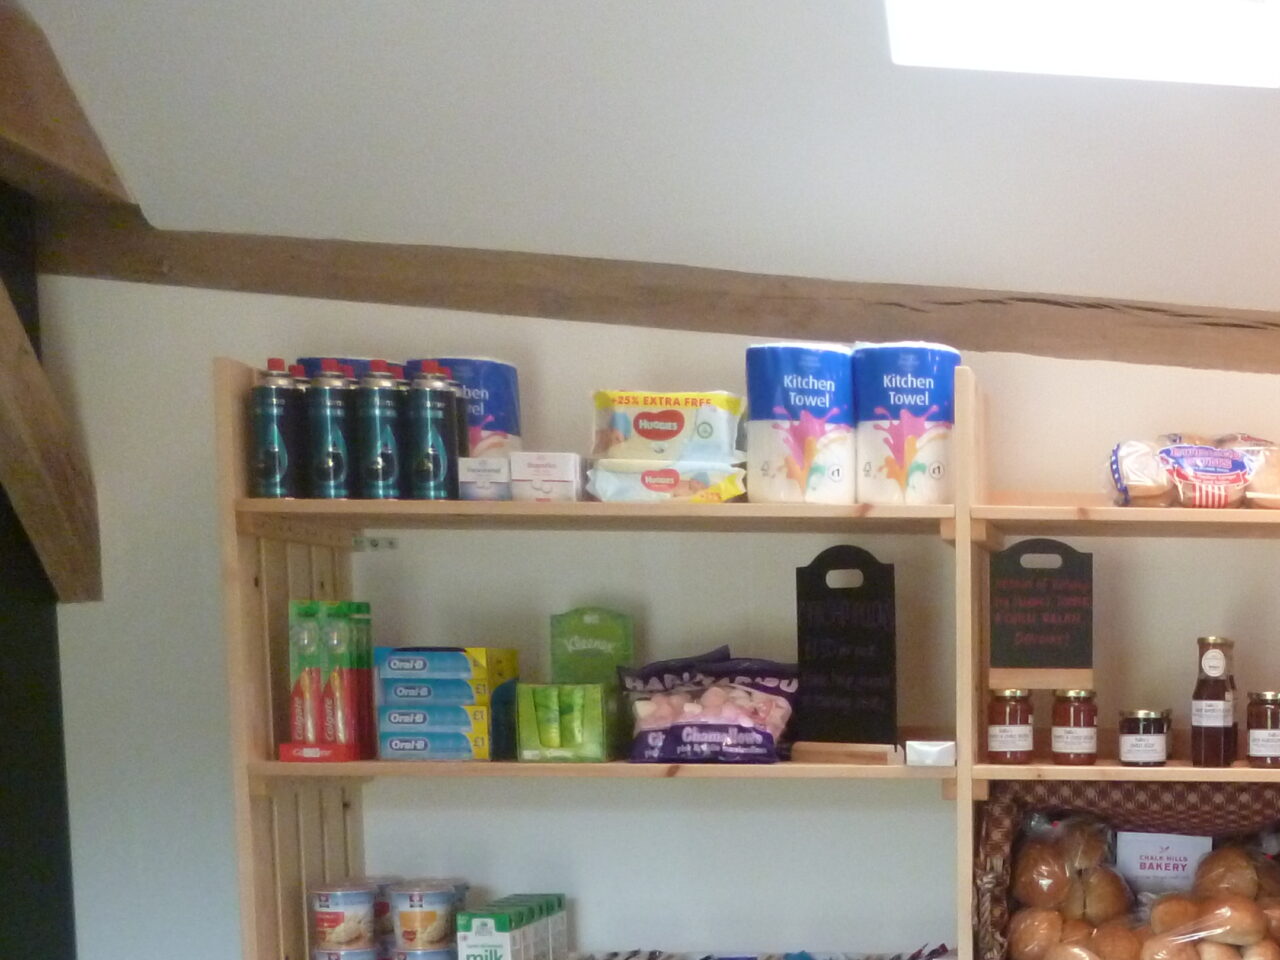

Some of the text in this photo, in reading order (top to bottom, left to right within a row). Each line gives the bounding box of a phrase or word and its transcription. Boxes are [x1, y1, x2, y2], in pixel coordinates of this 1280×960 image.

[783, 374, 835, 392] Kitchen
[883, 373, 934, 389] Kitchen
[643, 396, 681, 406] EXTRA
[789, 392, 830, 408] Towel
[889, 391, 929, 406] Towel
[390, 659, 424, 669] Oral-B
[396, 686, 429, 696] Oral-B
[293, 696, 305, 741] Colgate
[324, 696, 335, 742] Colgate
[390, 713, 424, 723] Oral-B
[391, 739, 425, 750] Oral-B
[1139, 862, 1188, 872] BAKERY
